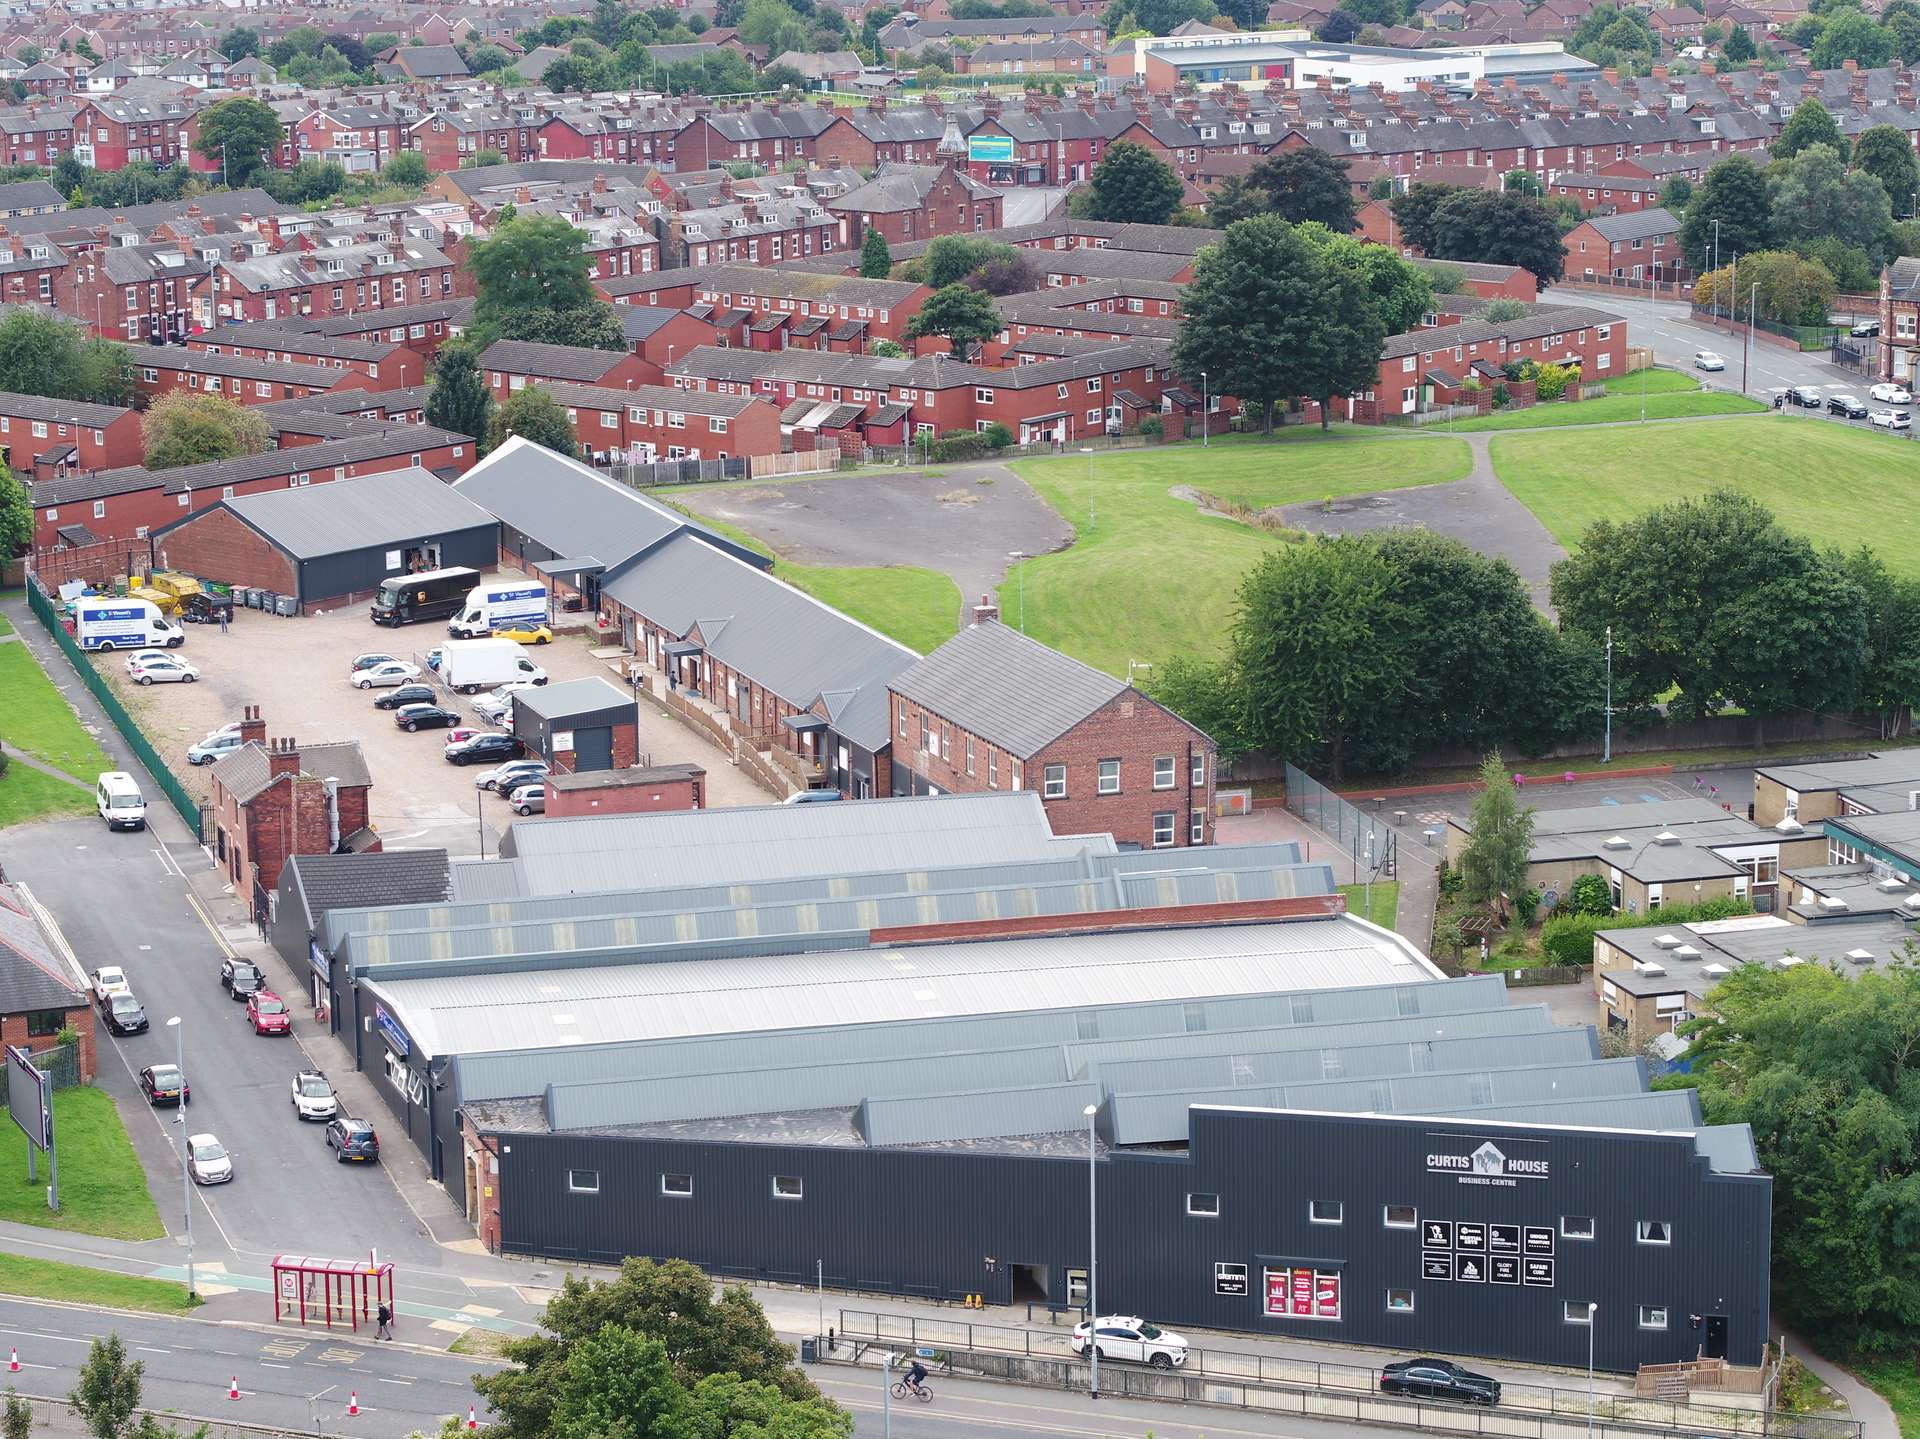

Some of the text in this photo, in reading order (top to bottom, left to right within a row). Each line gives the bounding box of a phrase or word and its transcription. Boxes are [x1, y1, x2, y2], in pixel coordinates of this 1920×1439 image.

[1427, 1155, 1549, 1173] CURTIS HOUSE
[1458, 1177, 1517, 1187] BUSINESS CENTRE
